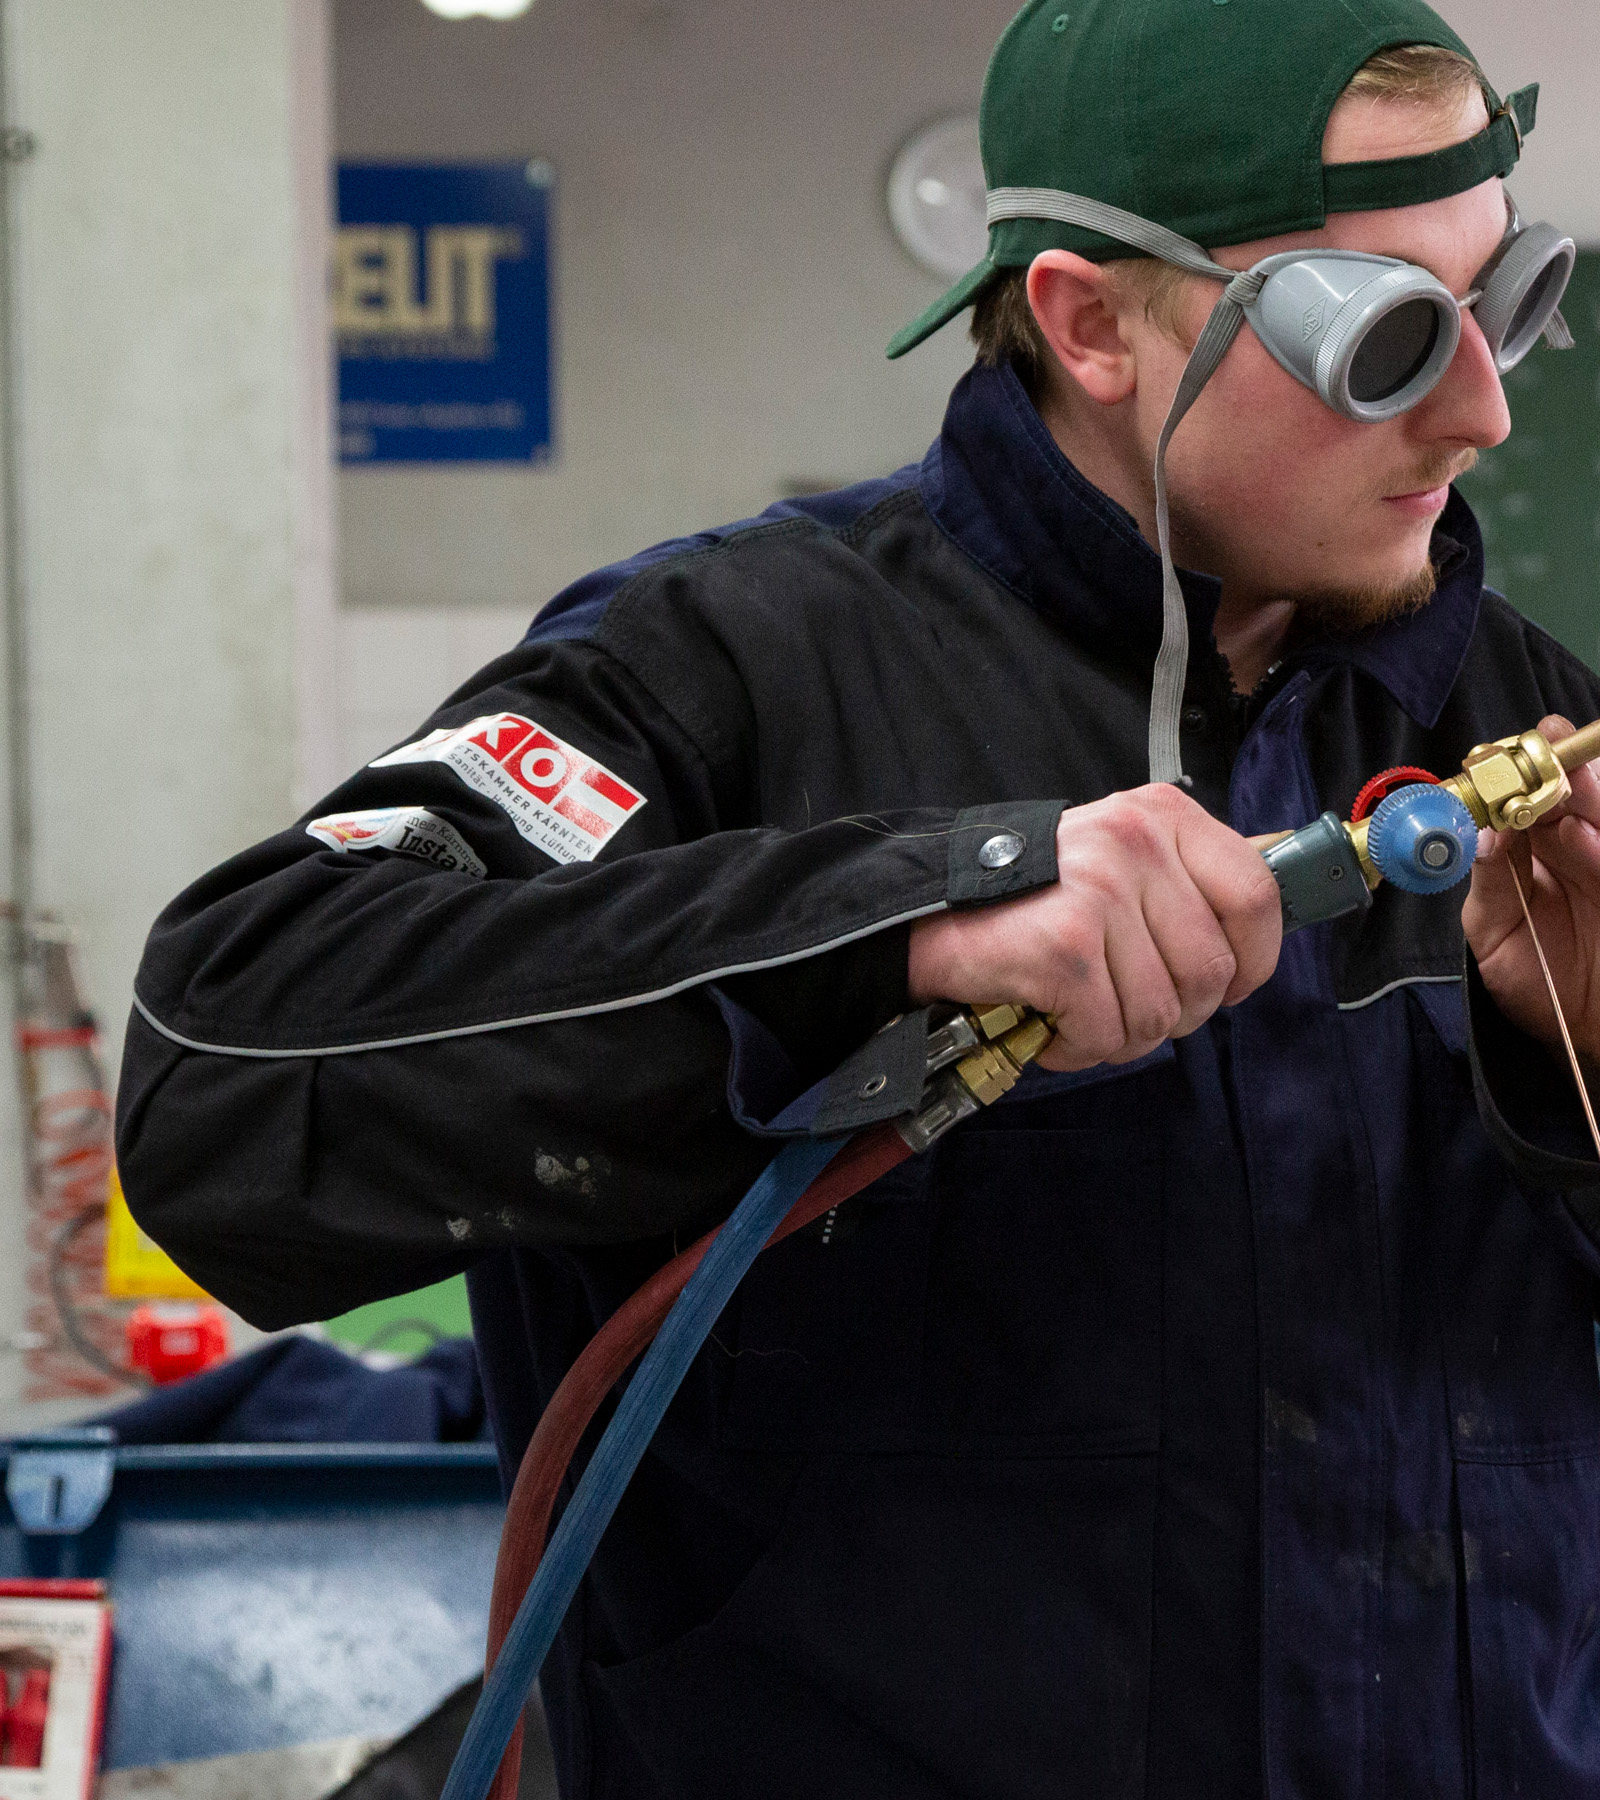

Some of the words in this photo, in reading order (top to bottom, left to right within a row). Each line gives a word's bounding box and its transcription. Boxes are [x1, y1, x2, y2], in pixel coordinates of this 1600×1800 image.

[447, 753, 486, 788] Sanitär
[540, 834, 580, 862] Lüftun
[532, 809, 596, 856] KÄRNTEN
